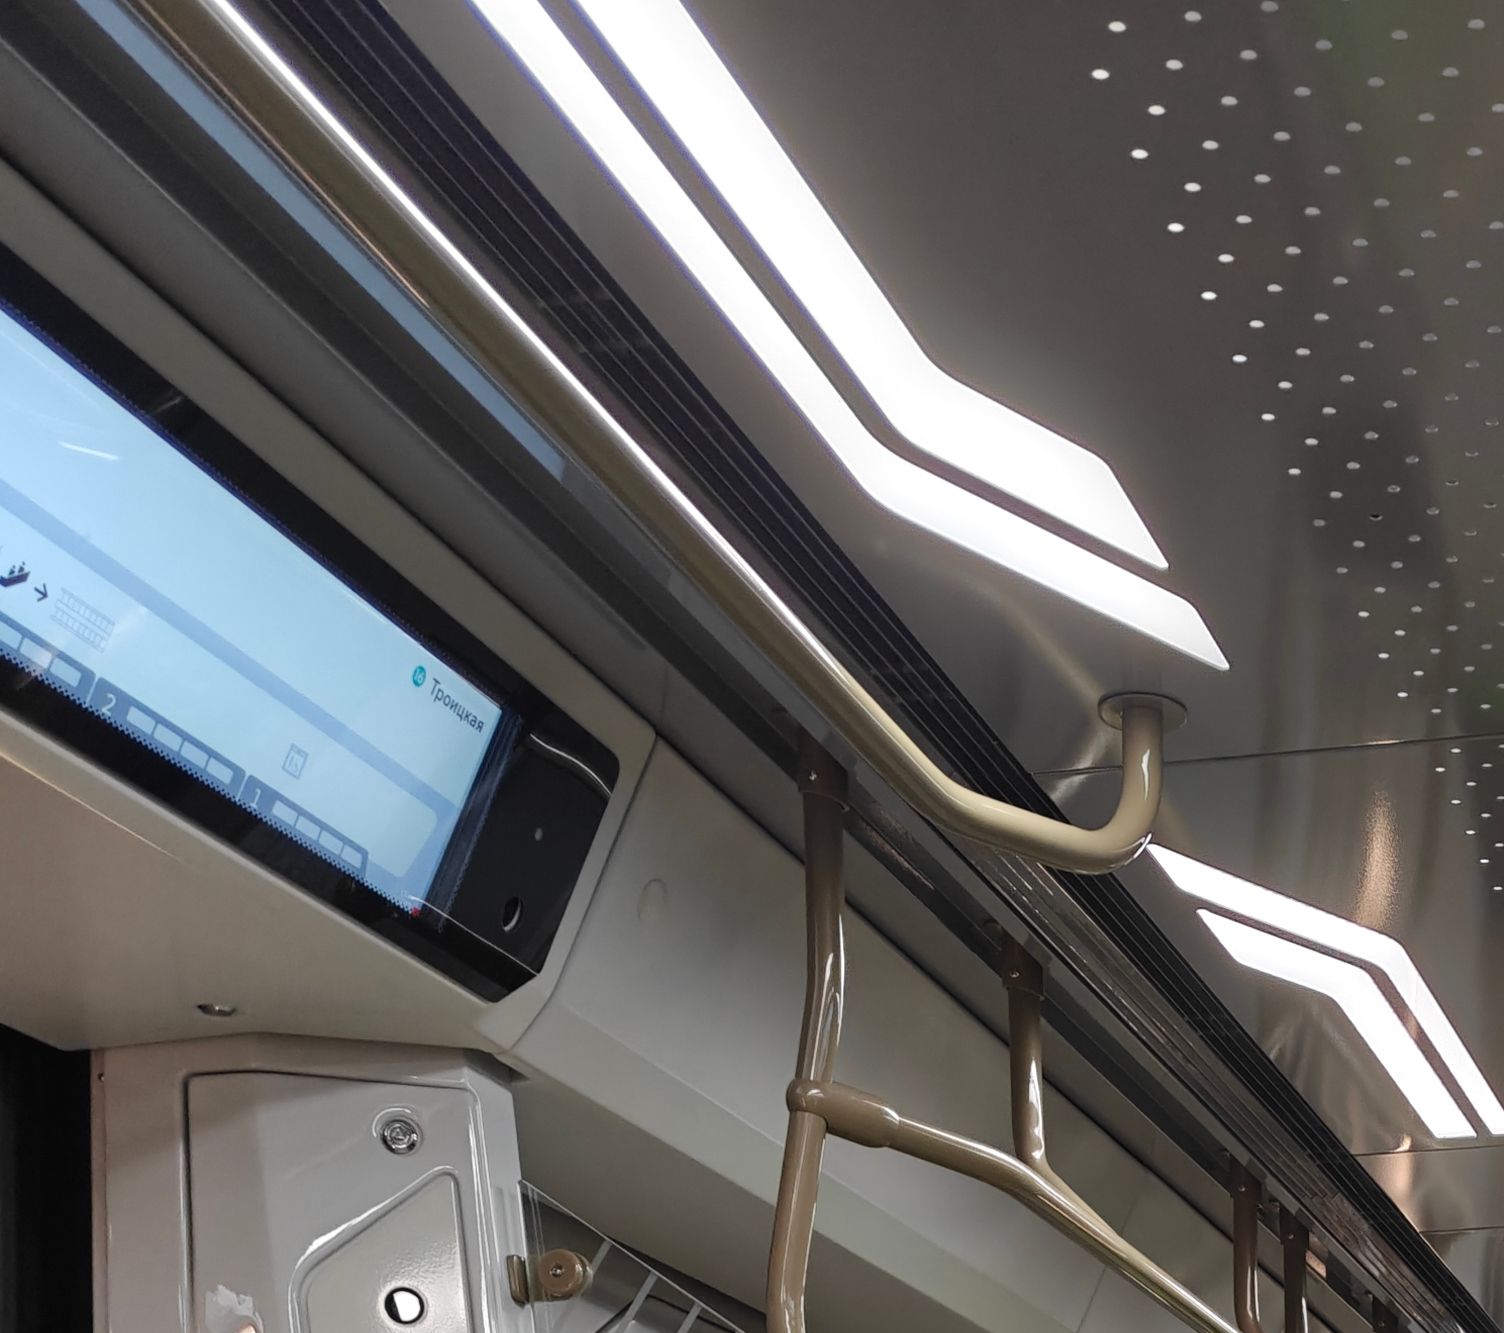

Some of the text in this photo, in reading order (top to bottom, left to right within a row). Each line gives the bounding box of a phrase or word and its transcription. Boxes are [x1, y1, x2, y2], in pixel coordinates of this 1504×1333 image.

[101, 693, 117, 716] 2
[430, 677, 485, 733] Троицкая
[250, 788, 261, 808] 1
